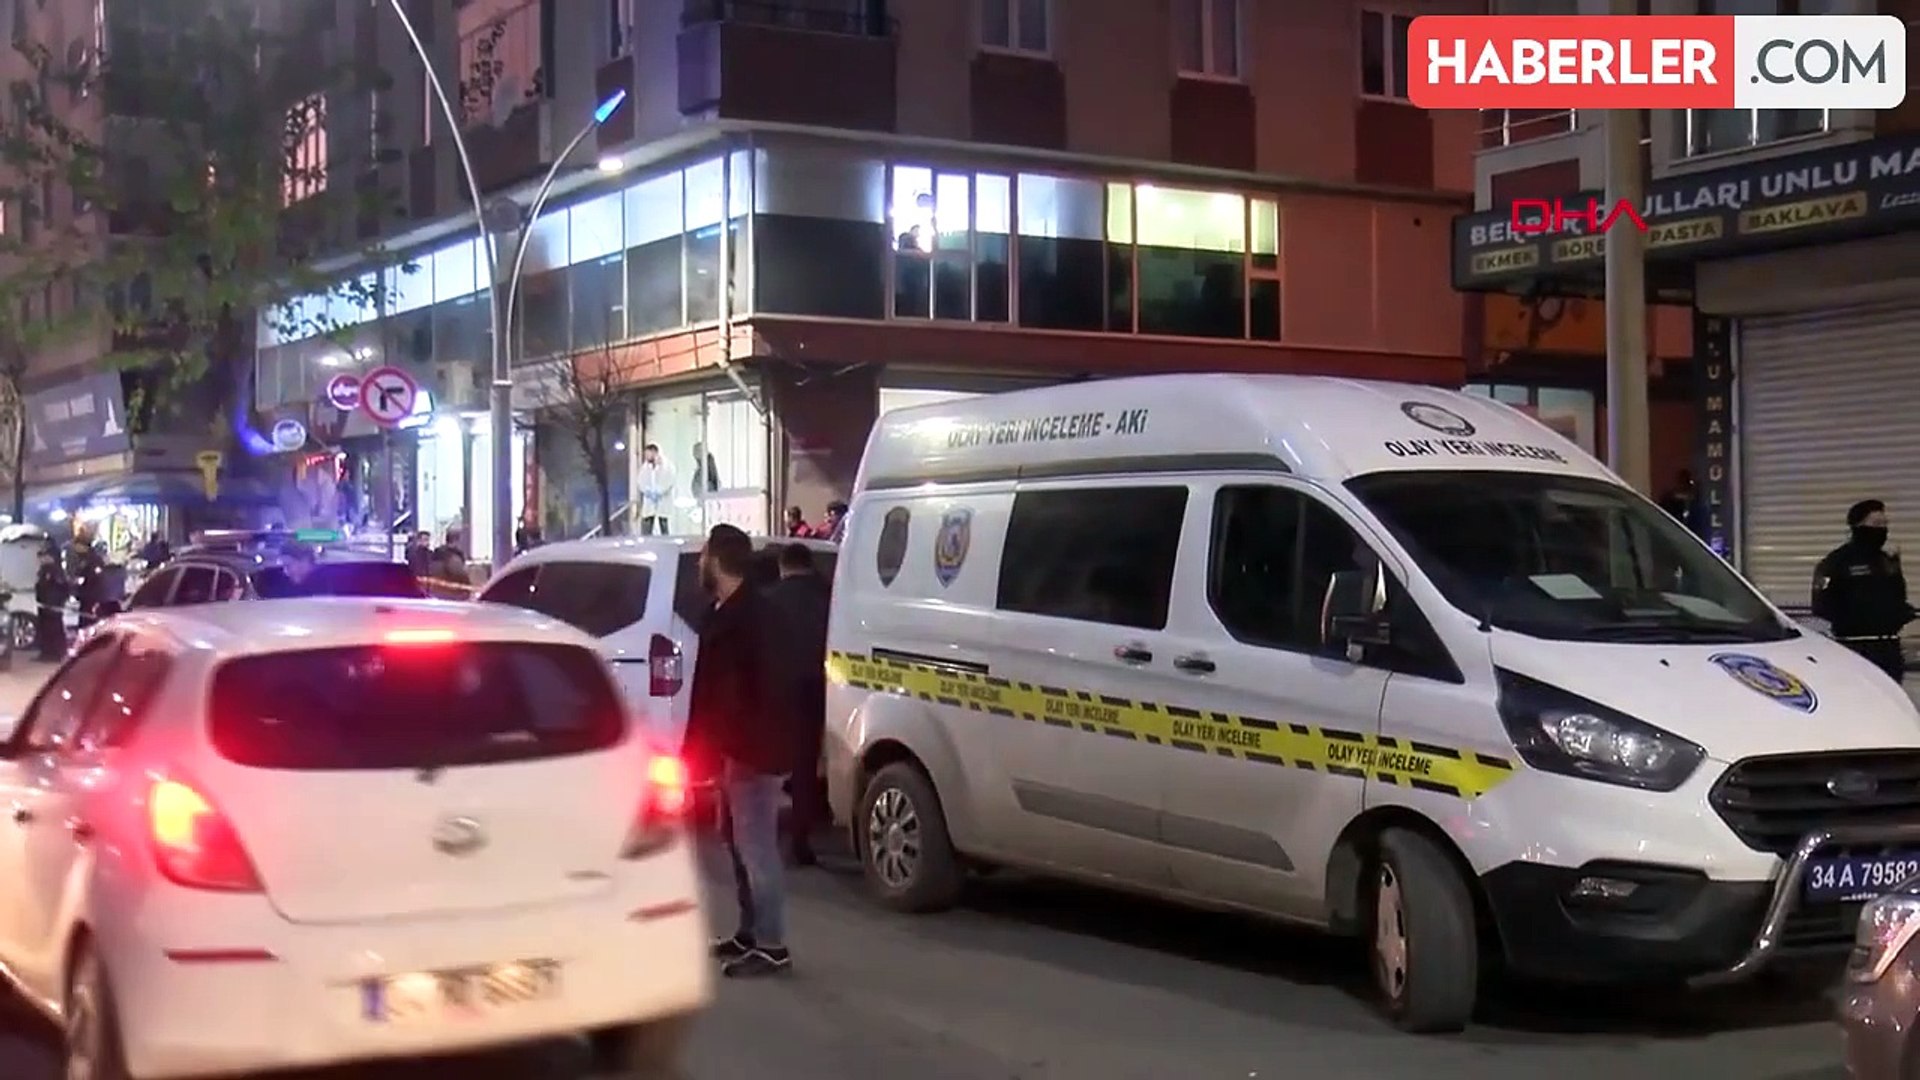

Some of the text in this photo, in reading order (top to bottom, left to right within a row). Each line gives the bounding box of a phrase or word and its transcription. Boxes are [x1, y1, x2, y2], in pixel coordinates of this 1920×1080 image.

[1760, 159, 1859, 198] UNLU
[1475, 251, 1535, 271] EKMEK
[1651, 221, 1717, 243] PASTA
[1749, 198, 1859, 228] BAKLAVA
[1384, 440, 1438, 458] OLAY
[1327, 743, 1354, 763] OLAY
[1811, 864, 1835, 889] 34
[1838, 863, 1854, 887] A
